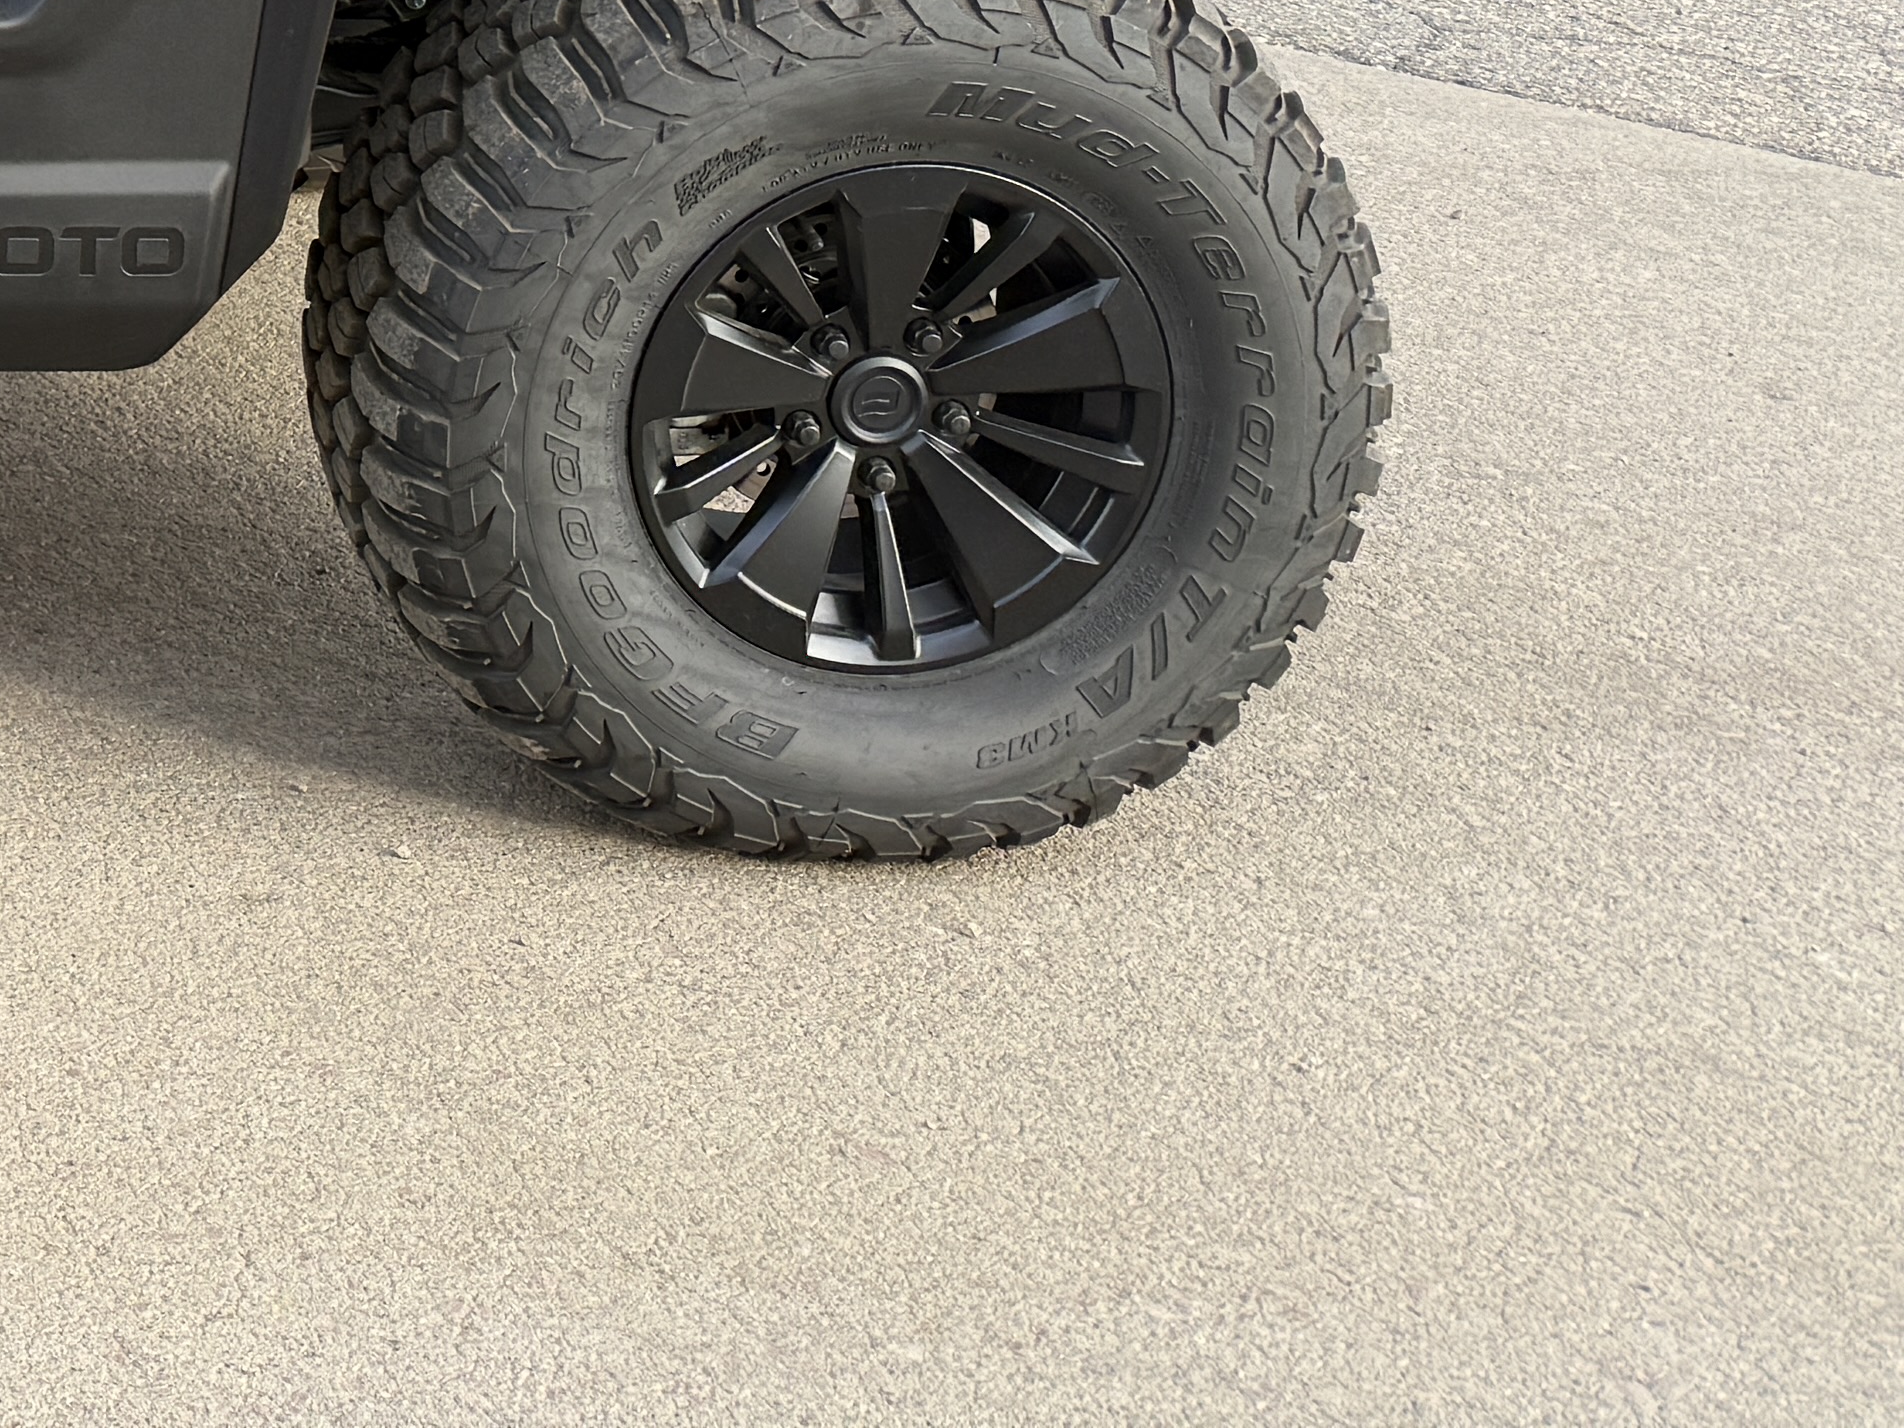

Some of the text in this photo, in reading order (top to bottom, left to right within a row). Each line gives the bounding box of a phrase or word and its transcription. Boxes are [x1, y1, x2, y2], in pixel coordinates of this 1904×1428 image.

[926, 81, 1276, 563] Mud-Terrain
[544, 219, 800, 760] BFGoodrich
[976, 711, 1078, 769] KM3
[1076, 575, 1229, 719] T/A
